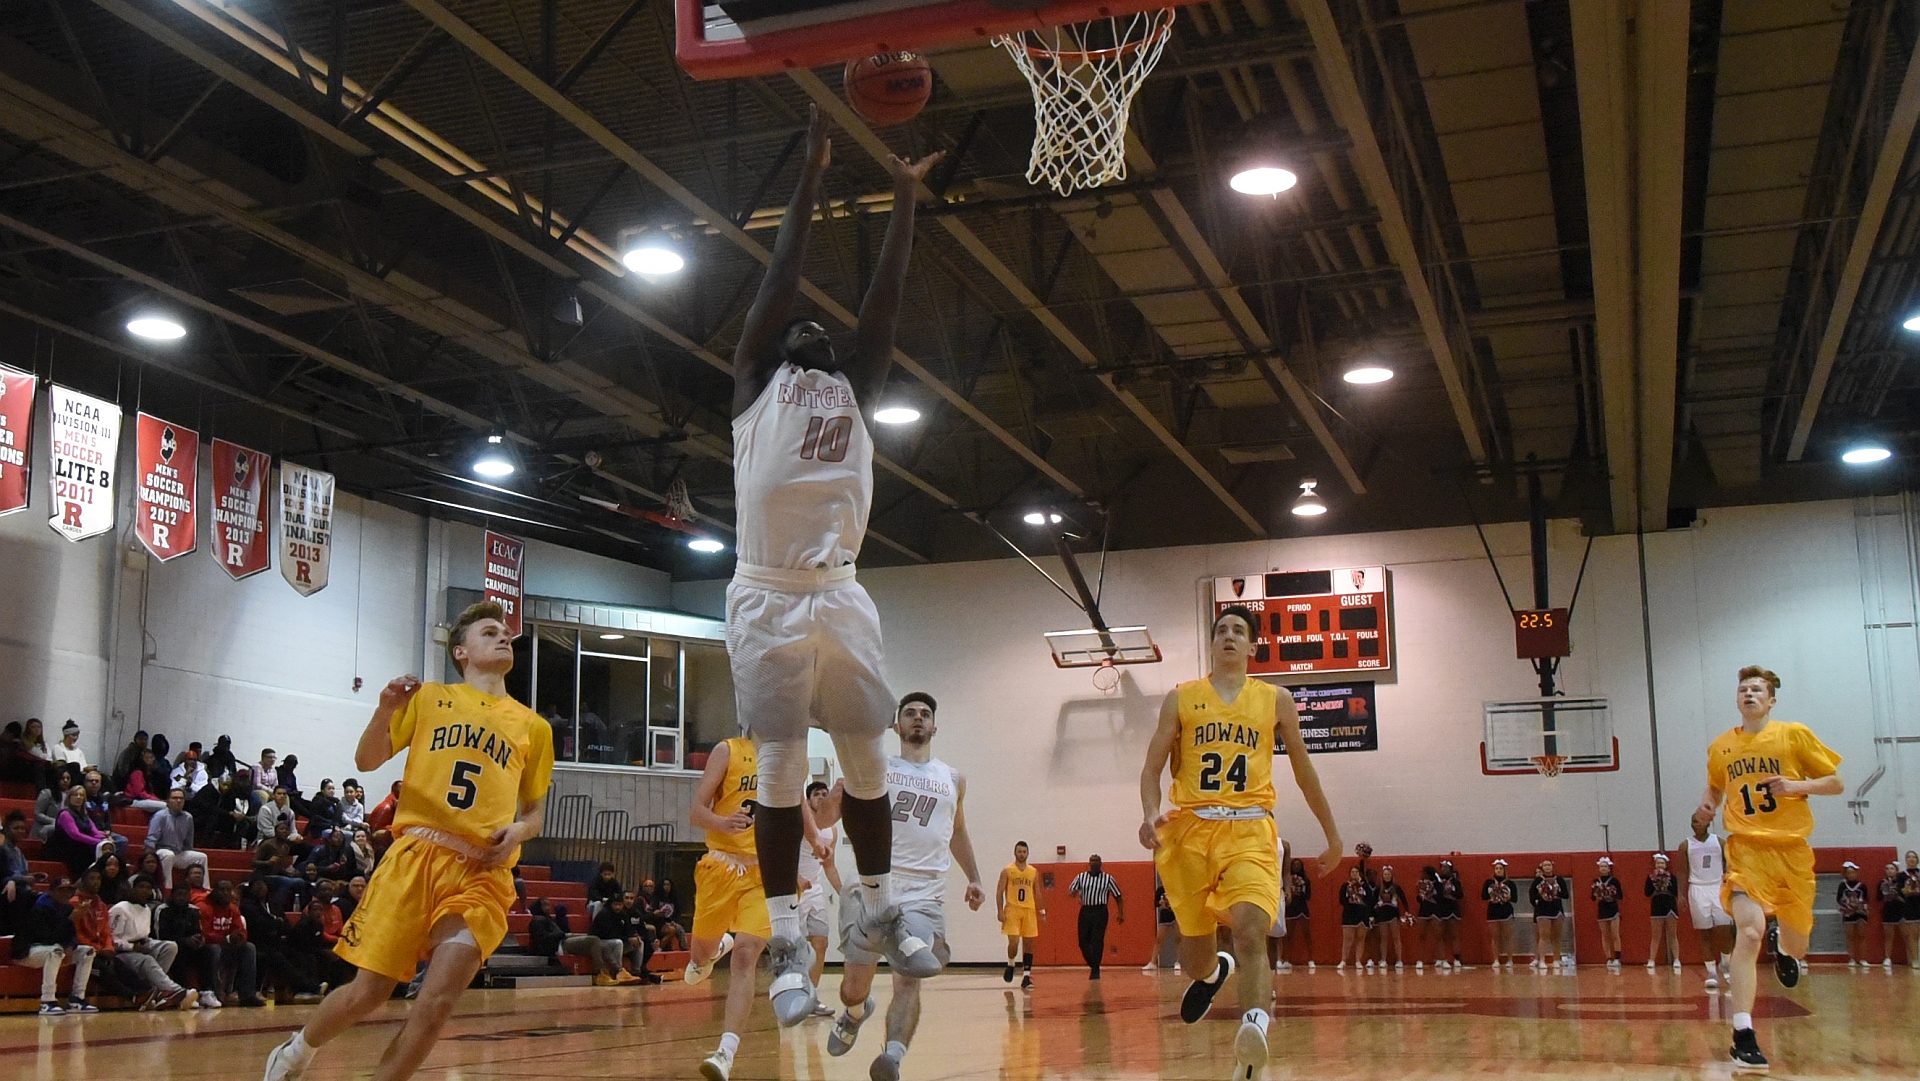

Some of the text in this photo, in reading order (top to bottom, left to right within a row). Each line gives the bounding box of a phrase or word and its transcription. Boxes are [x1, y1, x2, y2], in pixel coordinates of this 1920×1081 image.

[776, 383, 857, 410] RUTGE
[65, 398, 100, 421] NCAA
[65, 429, 97, 447] MENS
[101, 427, 111, 439] III
[799, 415, 854, 462] 10
[54, 440, 103, 466] SOCCER
[55, 458, 110, 489] LITE 8
[155, 462, 179, 478] MEN'S
[57, 480, 94, 505] 2011
[146, 473, 184, 496] SOCCER
[229, 485, 251, 500] MEN'S
[283, 484, 319, 503] DIVISON
[62, 501, 83, 528] R
[150, 506, 178, 526] 2012
[221, 495, 256, 516] SOCCER
[152, 523, 170, 549] R
[225, 526, 250, 545] 2013
[226, 542, 244, 567] R
[289, 542, 321, 563] 2013
[493, 539, 517, 561] ECAC
[296, 560, 312, 584] R
[488, 561, 519, 581] BASEBALL
[485, 577, 520, 598] CHAMPIONS
[1220, 601, 1266, 612] RERS
[1287, 603, 1312, 612] PERIOD
[1340, 594, 1373, 606] GUEST
[1519, 613, 1553, 629] 22.5
[1276, 635, 1302, 643] PLAYER
[1306, 633, 1324, 642] FOUL
[1356, 631, 1379, 639] FOULS
[1290, 660, 1381, 671] MATCH SCORE
[1347, 697, 1369, 718] R
[1193, 722, 1260, 750] ROWAN
[1299, 725, 1368, 738] IRNESS CIVILITY
[429, 724, 513, 771] ROWAN
[1199, 752, 1248, 793] 24
[1726, 757, 1782, 783] ROWAN
[446, 759, 483, 812] 5
[886, 771, 950, 797] RUTGERS
[891, 790, 938, 828] 24
[1739, 782, 1778, 816] 13
[1018, 888, 1026, 902] 0
